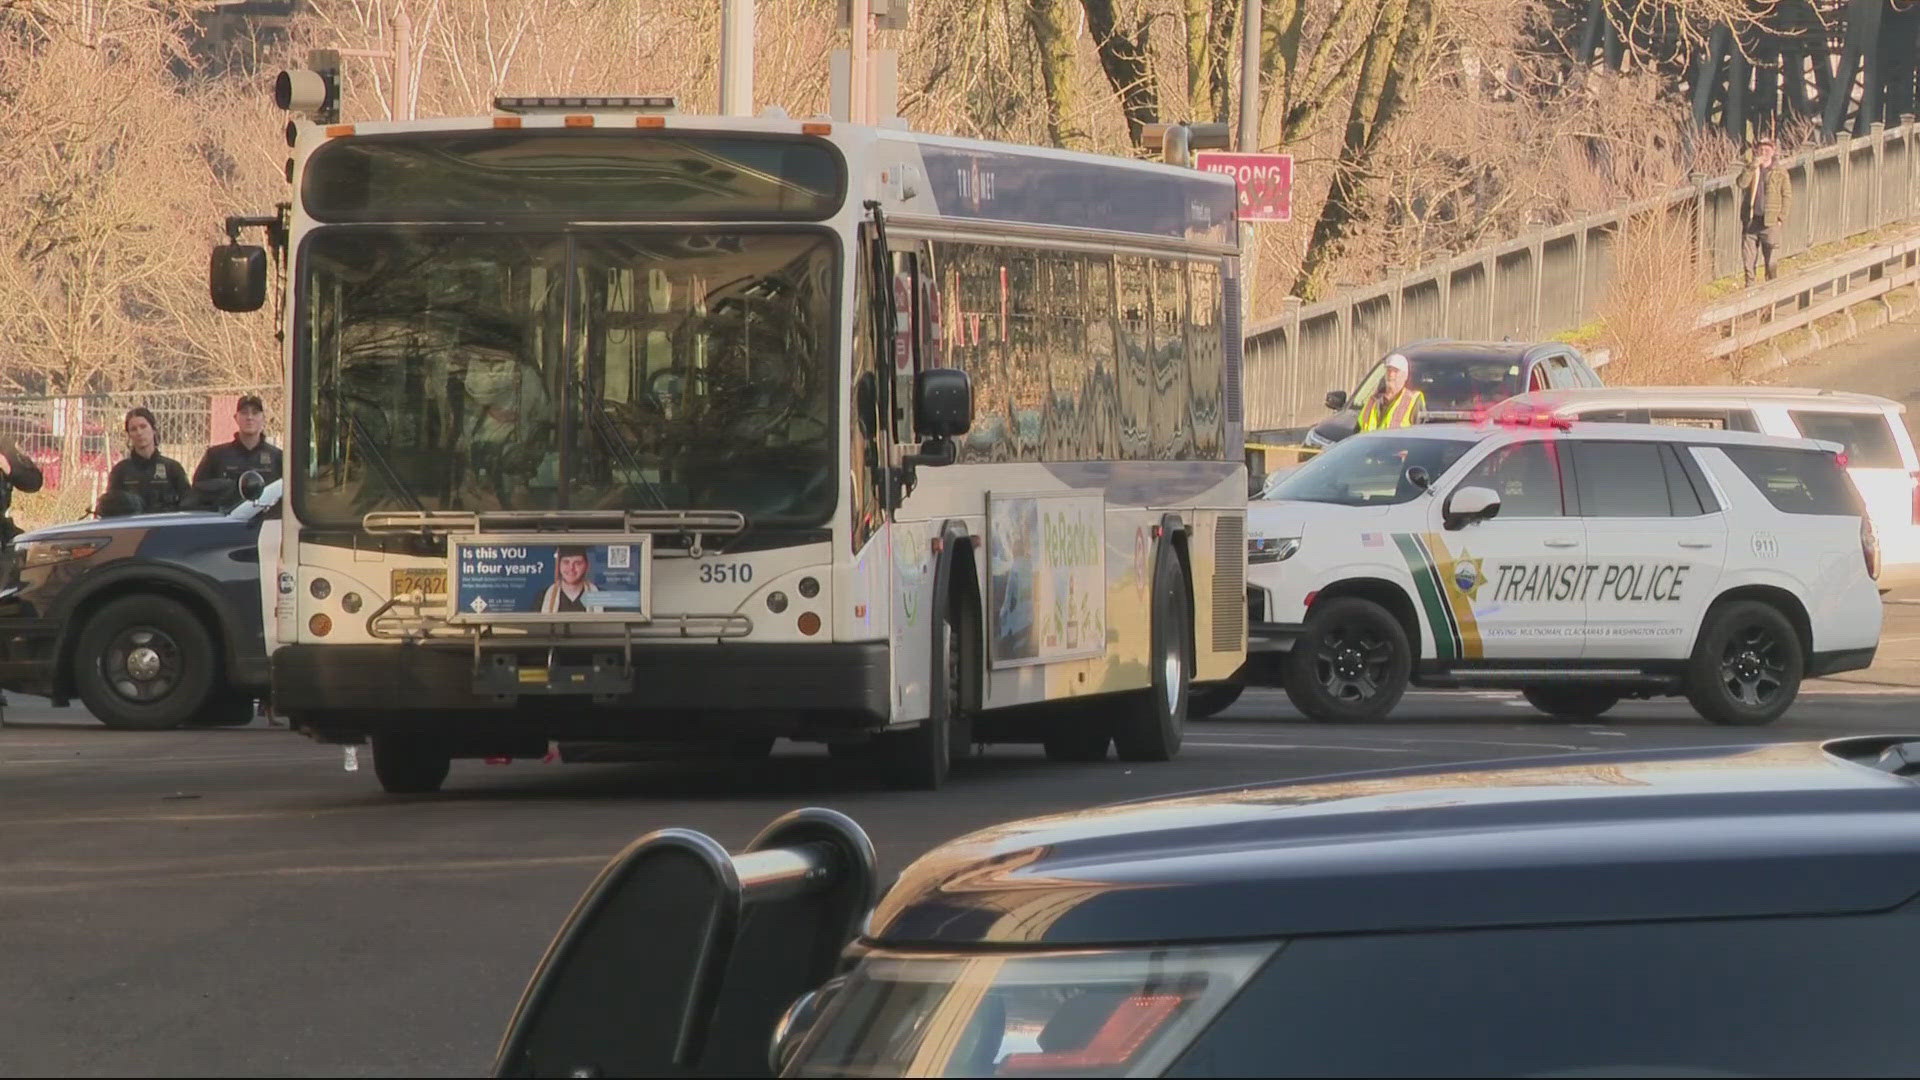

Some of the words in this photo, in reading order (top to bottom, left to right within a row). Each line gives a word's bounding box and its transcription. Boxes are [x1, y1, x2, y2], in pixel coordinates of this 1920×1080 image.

[463, 547, 473, 559] Is
[475, 546, 498, 559] this
[500, 547, 527, 559] YOU
[1755, 540, 1774, 552] 911
[477, 561, 502, 574] four
[505, 561, 544, 576] years?
[700, 563, 753, 583] 3510
[1493, 564, 1599, 601] TRANSIT
[1599, 564, 1690, 601] POLICE
